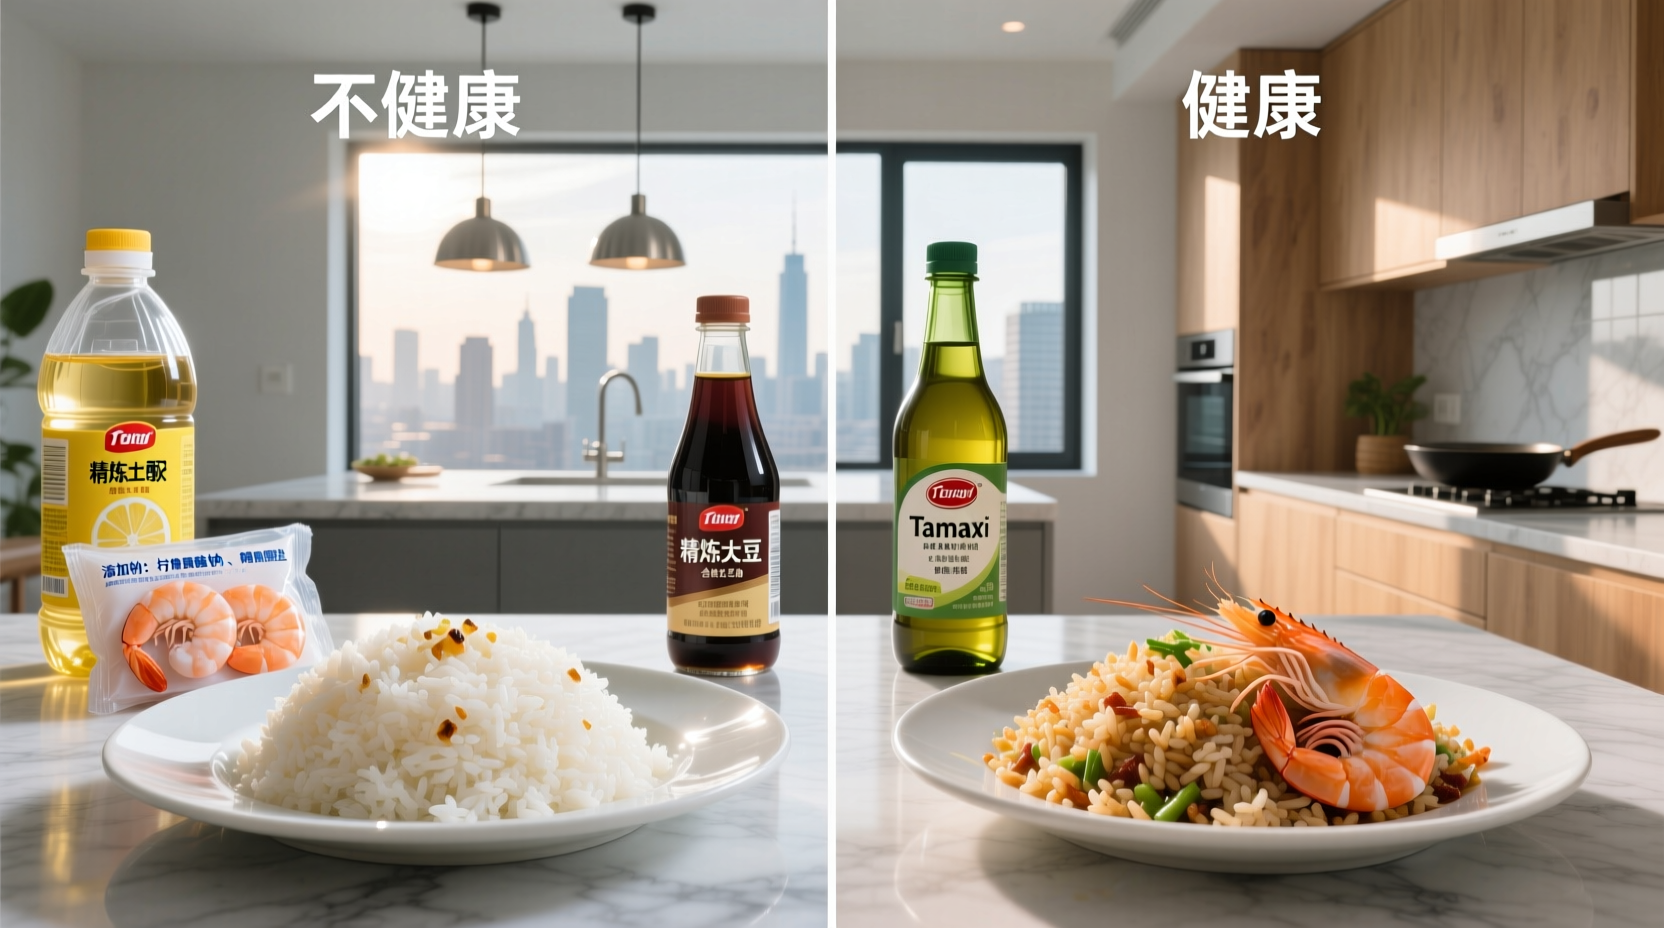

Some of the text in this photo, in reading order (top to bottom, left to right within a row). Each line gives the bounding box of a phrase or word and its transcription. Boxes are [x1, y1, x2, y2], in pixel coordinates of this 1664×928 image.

[909, 515, 989, 538] Tamaxi
[680, 537, 762, 564] 精炼大豆
